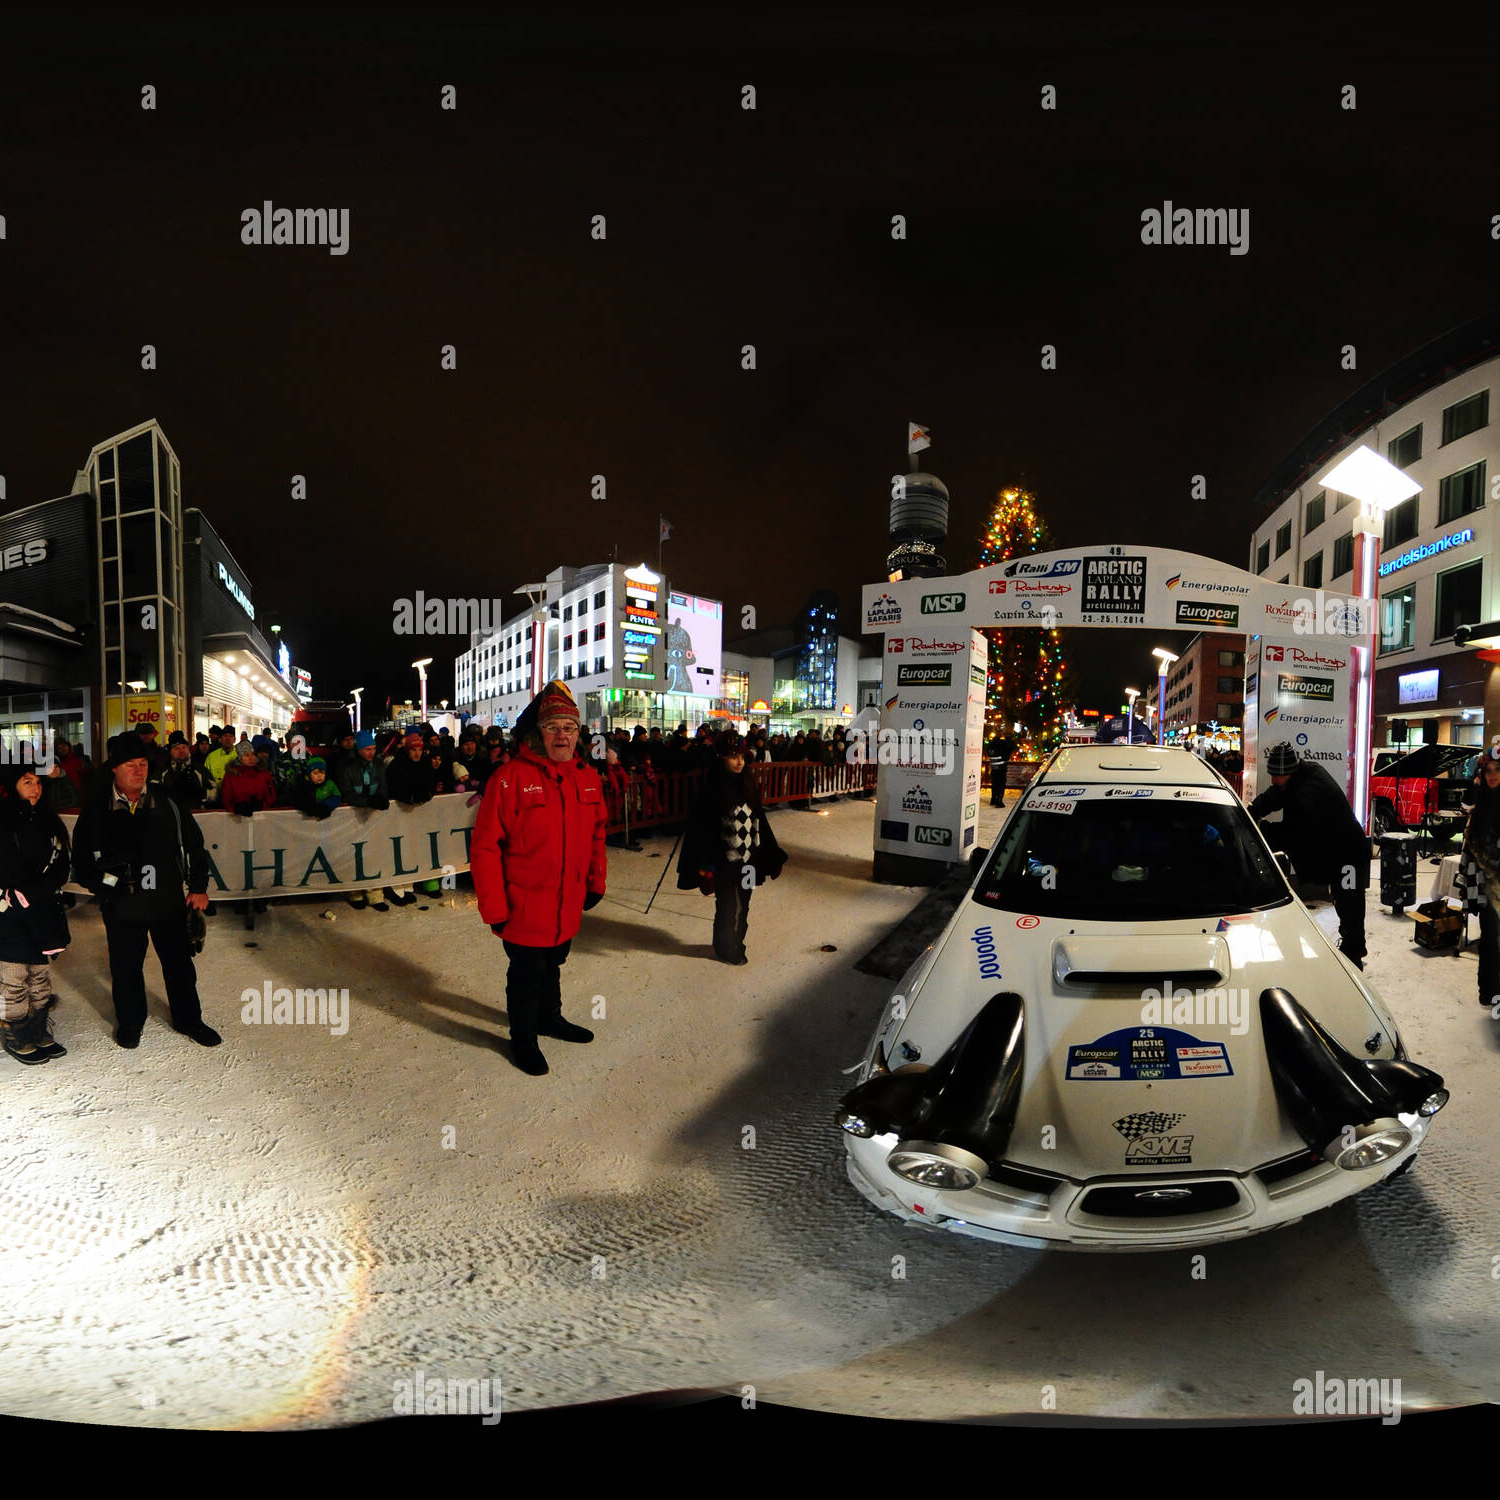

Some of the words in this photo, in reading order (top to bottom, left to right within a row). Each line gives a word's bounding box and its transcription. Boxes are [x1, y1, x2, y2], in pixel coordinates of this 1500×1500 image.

[1018, 563, 1049, 573] Ralli
[1054, 561, 1079, 573] SM
[1087, 560, 1143, 575] ARCTIC
[1087, 575, 1143, 584] LAPLAND
[218, 562, 255, 620] PUKUMIES
[1086, 585, 1143, 600] RALLY
[1181, 580, 1250, 594] Energiapolar
[924, 594, 963, 612] MSP
[867, 607, 902, 616] LAPLAND
[1178, 604, 1237, 621] Europcar
[867, 614, 902, 623] SAFARIS
[624, 630, 657, 645] Sportia
[900, 667, 950, 683] Europcar
[1280, 679, 1332, 696] Europcar
[898, 701, 963, 710] Energiapolar
[128, 708, 160, 723] Sale
[1279, 714, 1344, 725] Energiapolar
[1068, 788, 1085, 796] SM
[902, 797, 933, 805] LAPLAND
[902, 803, 933, 811] SAFARIS
[1026, 800, 1073, 812] GJ-8190
[917, 827, 950, 844] MSP
[970, 926, 1002, 979] uponor
[1140, 1029, 1154, 1038] 25
[1132, 1039, 1164, 1047] ARCTIC
[1075, 1050, 1118, 1059] Europcar
[1132, 1050, 1165, 1058] RALLY
[1125, 1134, 1194, 1156] KWE
